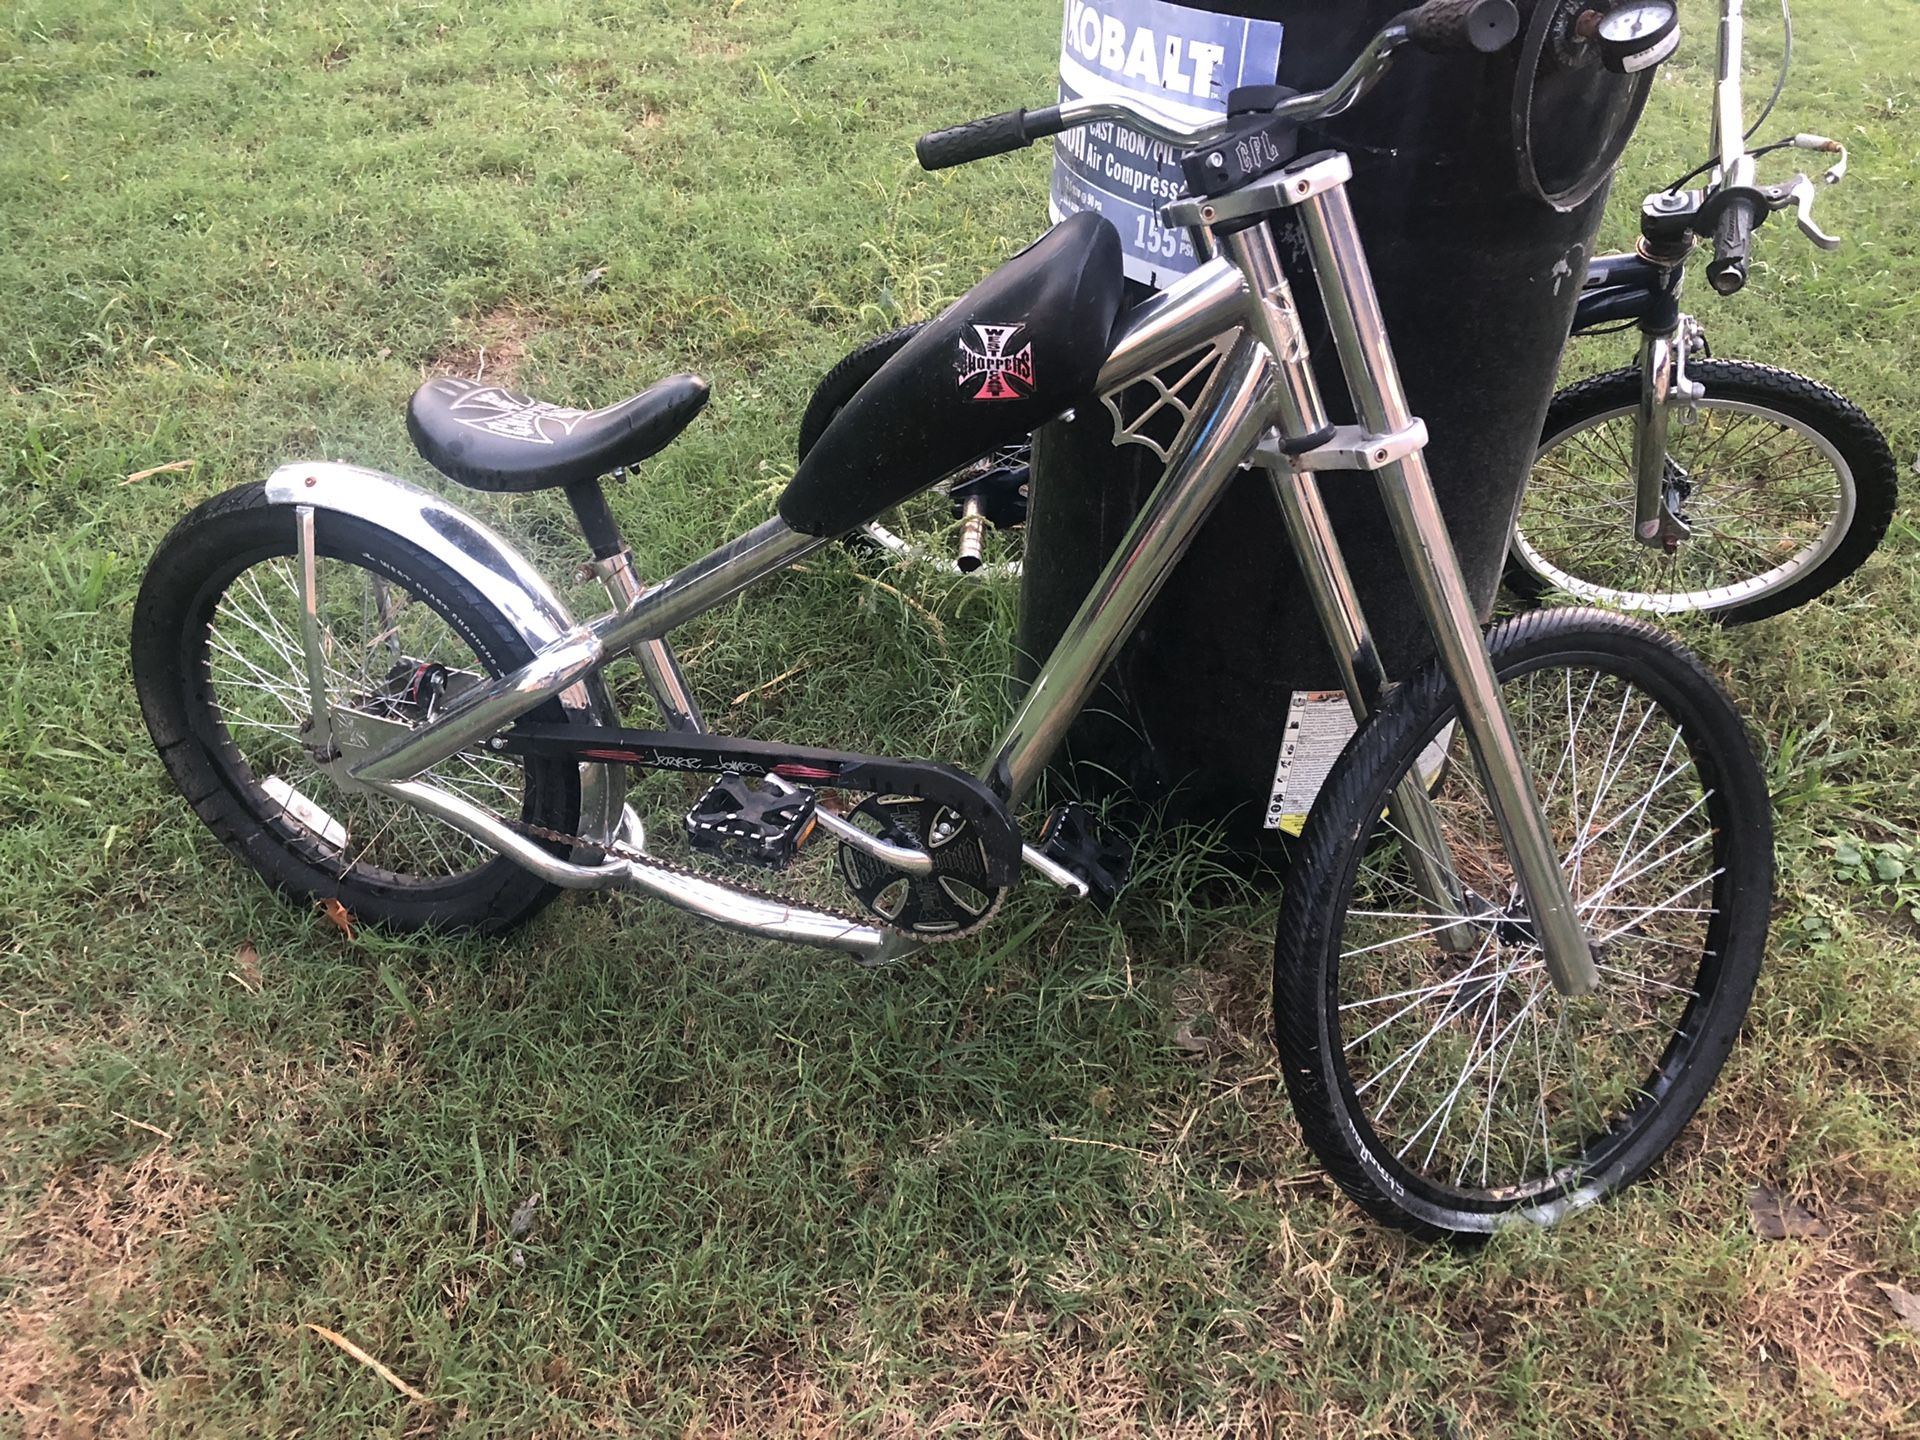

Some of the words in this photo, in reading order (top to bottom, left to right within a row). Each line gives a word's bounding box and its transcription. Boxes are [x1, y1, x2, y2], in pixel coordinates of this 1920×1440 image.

[1067, 3, 1225, 98] KOBALT
[1086, 143, 1102, 171] Air
[1090, 122, 1114, 143] CAST
[1116, 127, 1176, 166] IRON/OIL
[1134, 214, 1177, 258] 155
